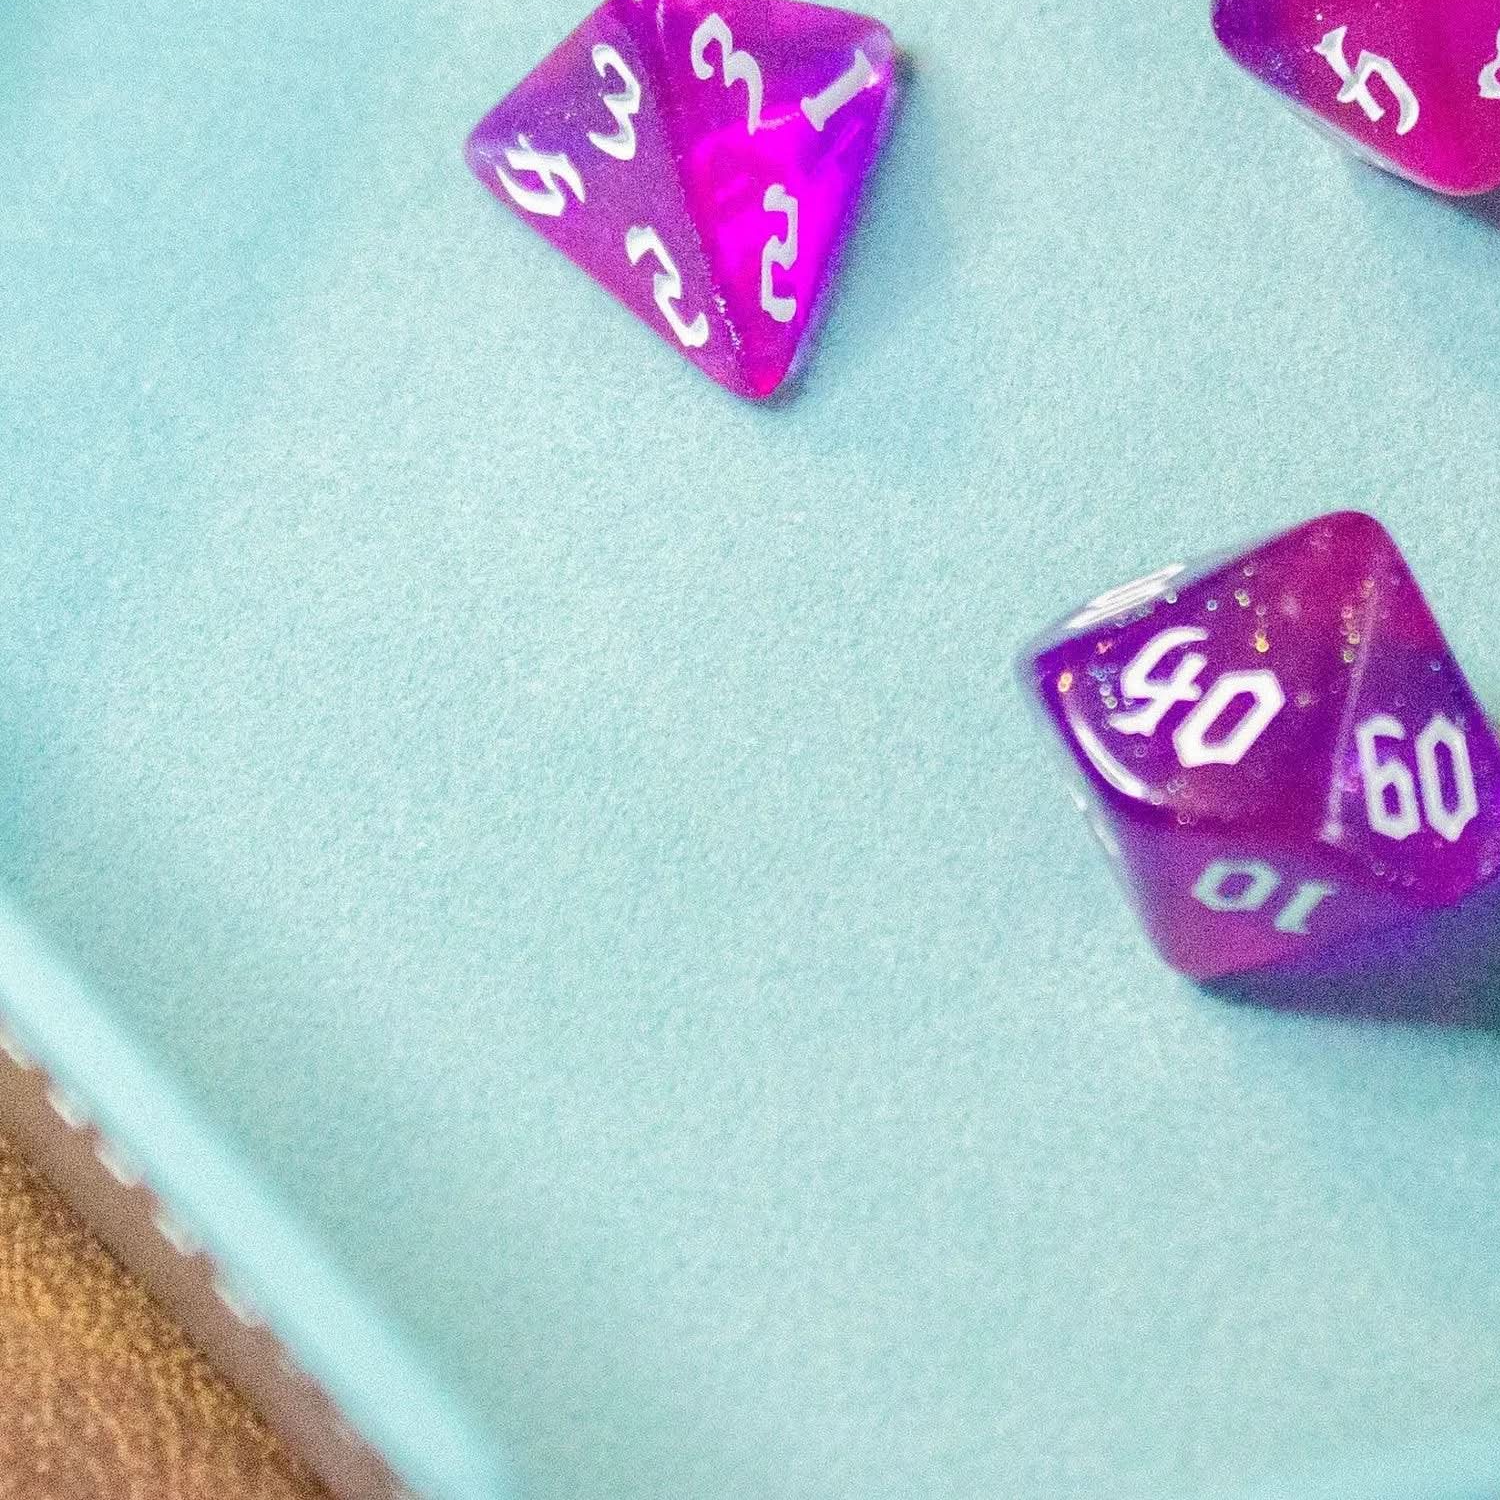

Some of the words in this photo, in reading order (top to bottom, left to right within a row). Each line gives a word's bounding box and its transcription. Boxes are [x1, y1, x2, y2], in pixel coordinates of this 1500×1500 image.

[588, 44, 641, 161] 3
[691, 13, 764, 135] 3
[800, 50, 876, 131] 1
[1314, 25, 1419, 135] 4
[626, 225, 709, 347] 2
[761, 183, 799, 323] 2
[1108, 626, 1286, 768] 40
[1355, 713, 1478, 842] 60
[1192, 858, 1339, 935] 10
